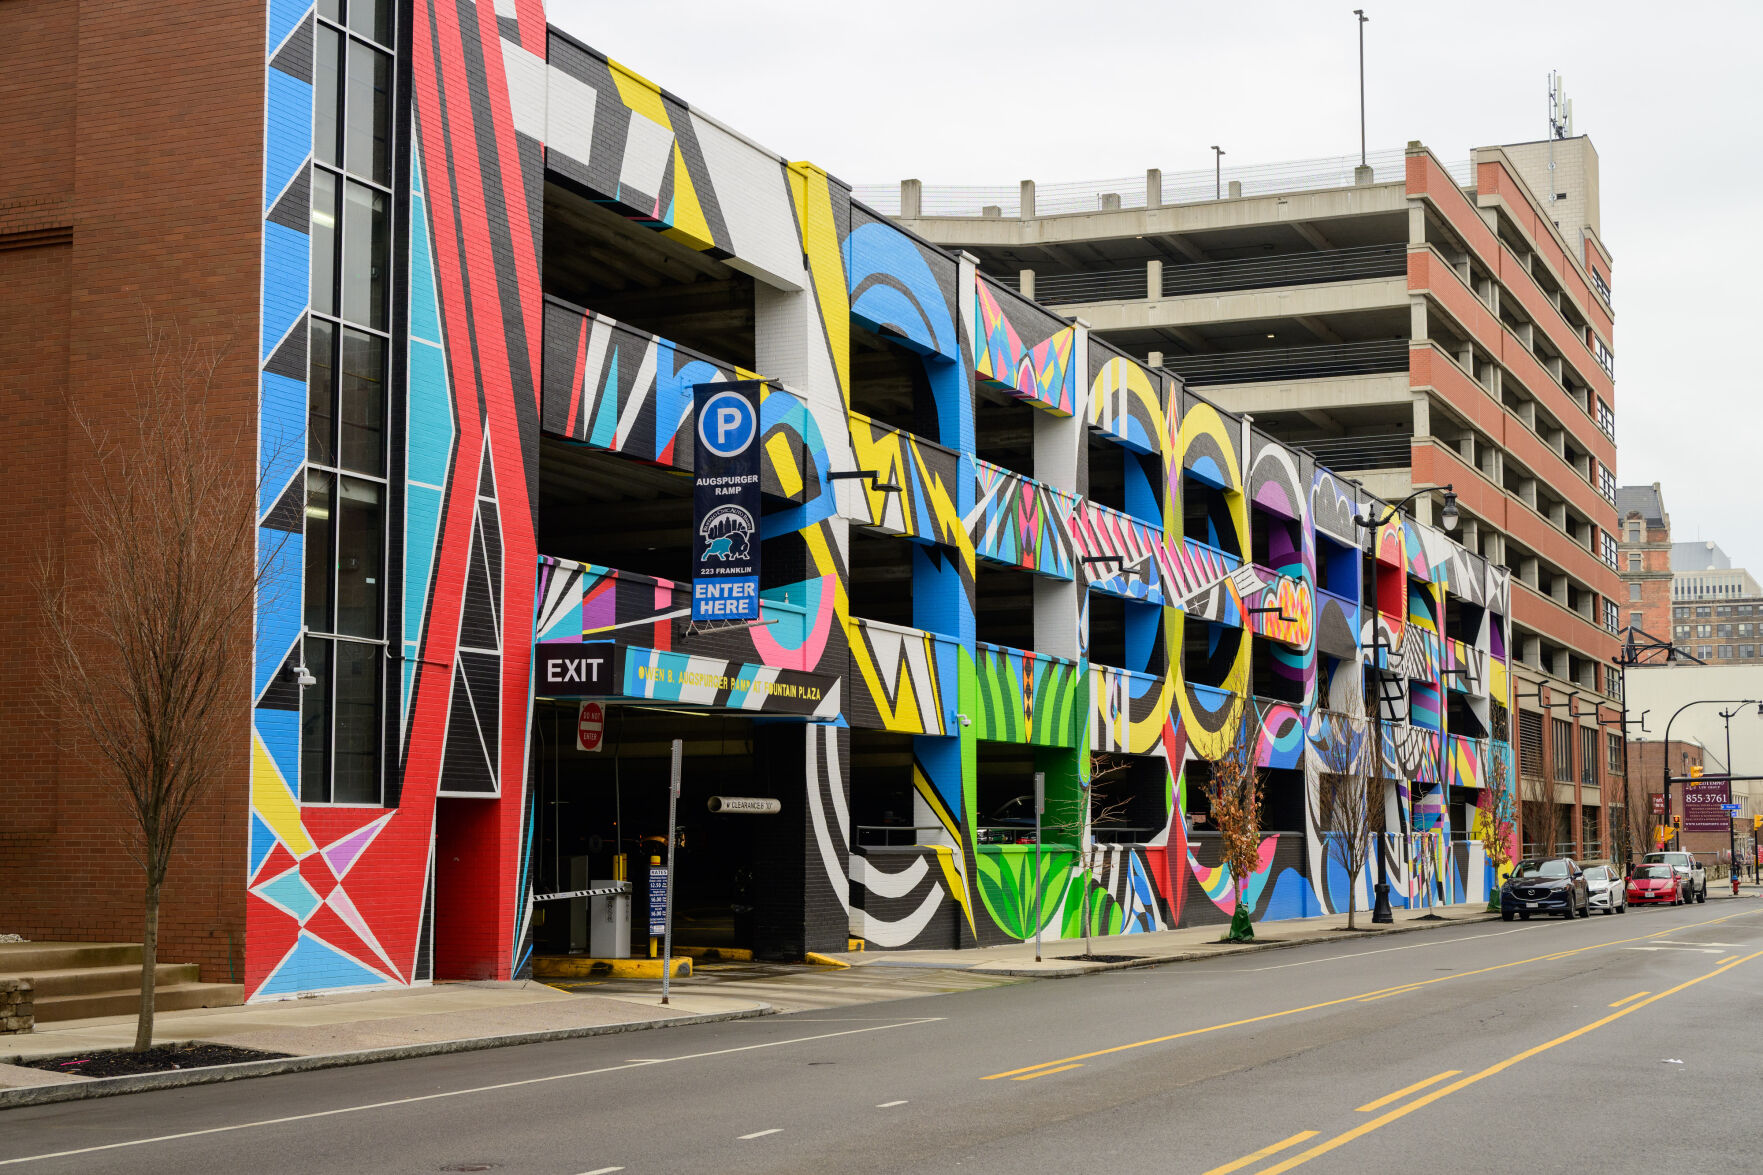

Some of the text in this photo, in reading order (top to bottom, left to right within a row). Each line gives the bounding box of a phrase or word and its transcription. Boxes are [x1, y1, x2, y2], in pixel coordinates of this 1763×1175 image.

[717, 407, 742, 444] P
[696, 474, 759, 486] AUGSPURGER
[715, 486, 742, 496] RAMP
[715, 566, 752, 574] FRANKLIN
[695, 582, 755, 598] ENTER
[700, 599, 749, 615] HERE
[547, 658, 604, 682] EXIT
[638, 666, 665, 682] OWEN
[678, 672, 728, 689] AUGSPURGER
[730, 677, 751, 692] RAMP
[753, 680, 762, 693] AT
[764, 681, 797, 698] FOUNTAIN
[798, 685, 821, 700] PLAZA
[583, 711, 600, 720] DO NOT
[583, 732, 597, 740] ENTER
[731, 801, 761, 809] CLEARANCE
